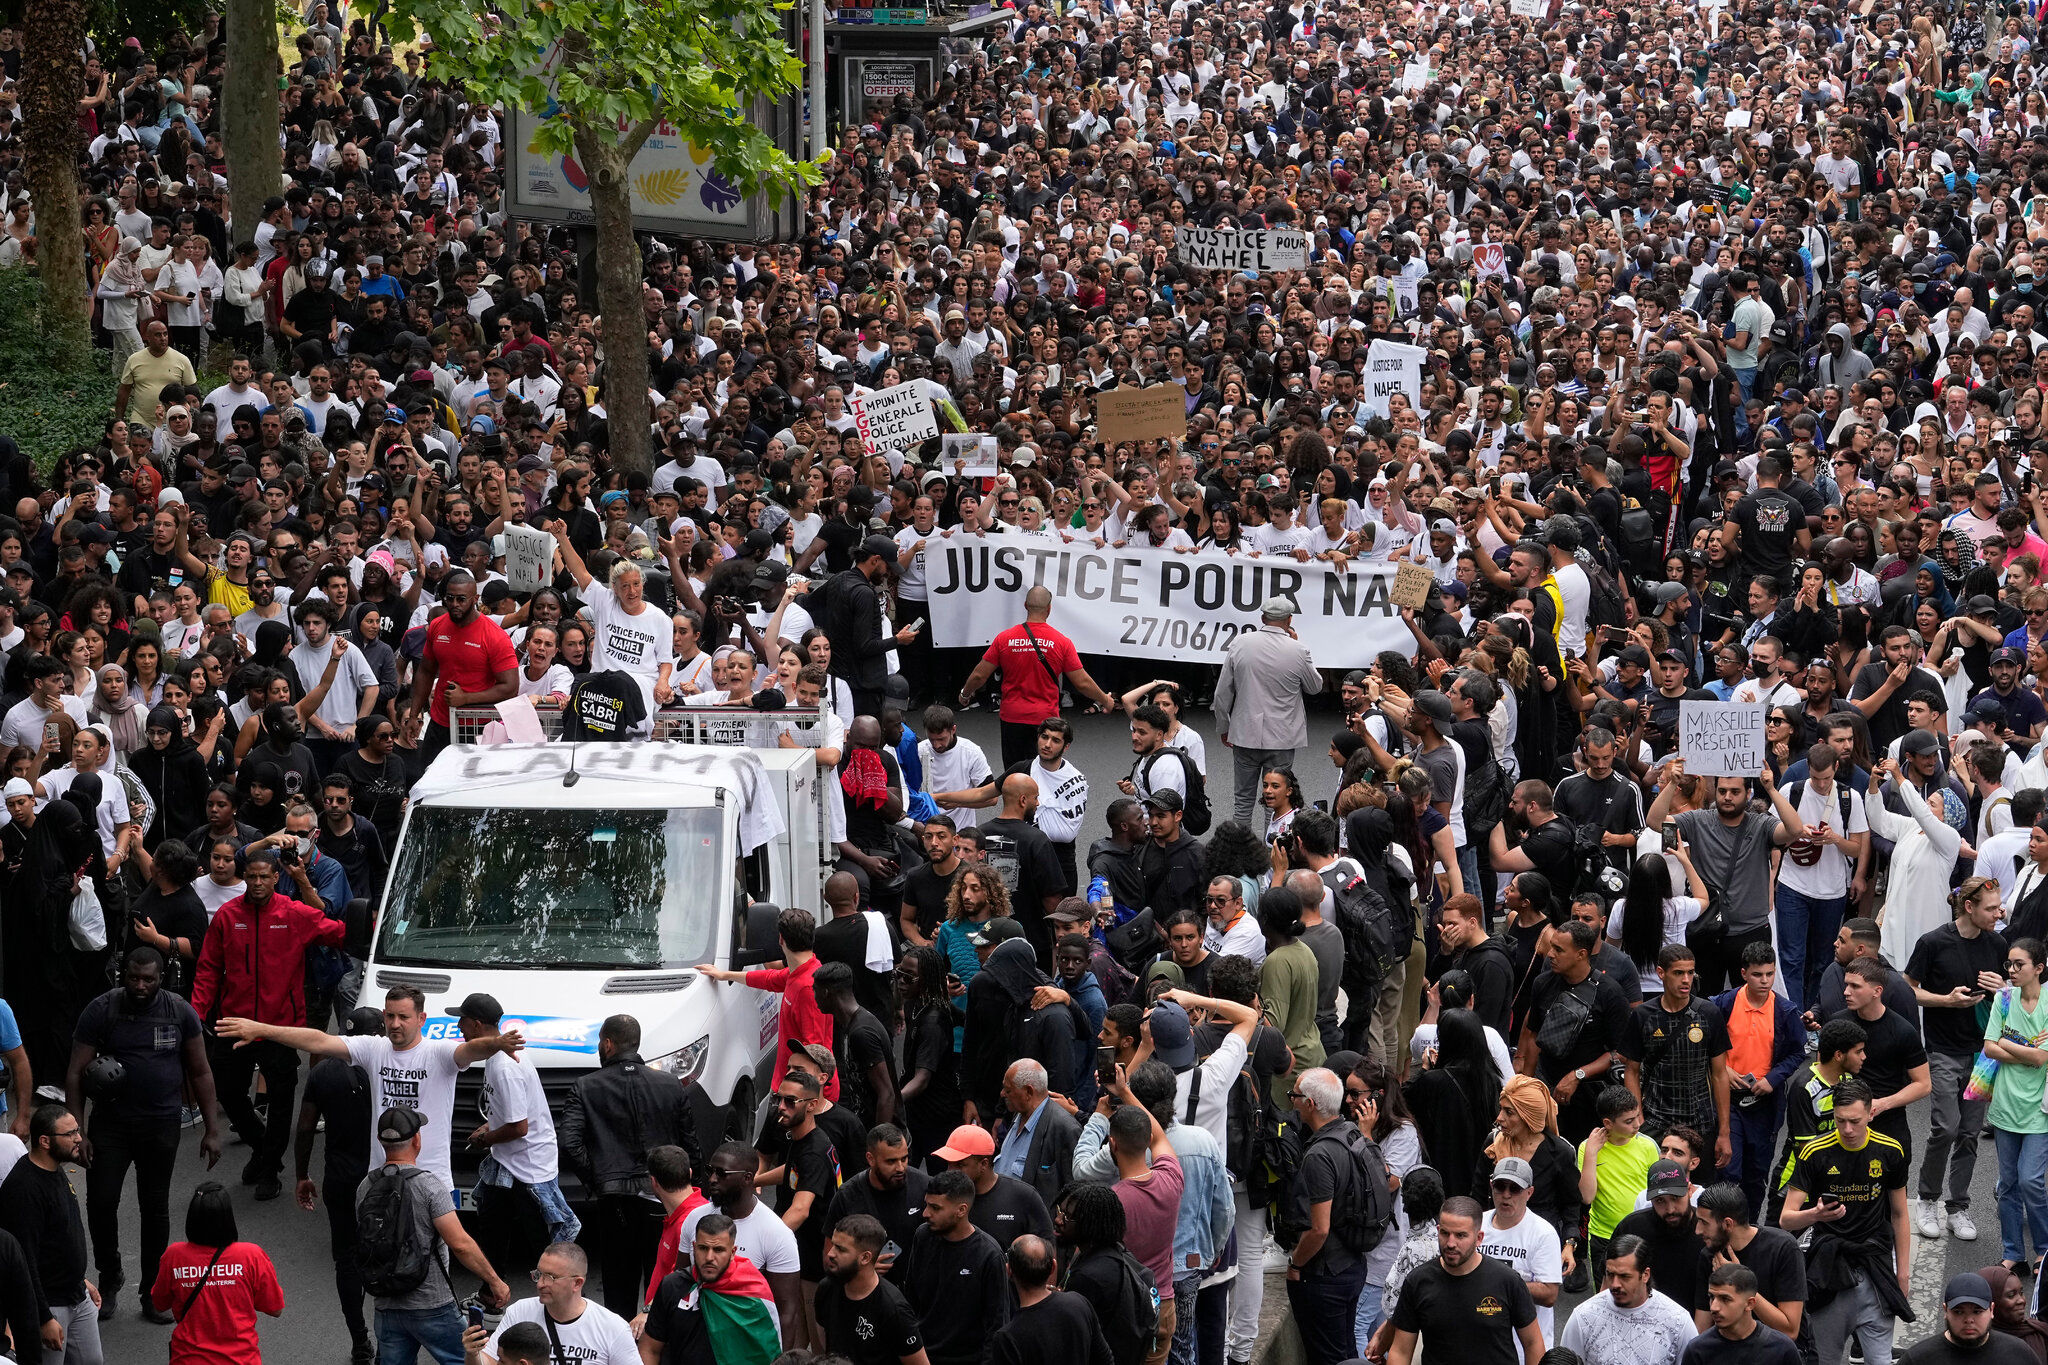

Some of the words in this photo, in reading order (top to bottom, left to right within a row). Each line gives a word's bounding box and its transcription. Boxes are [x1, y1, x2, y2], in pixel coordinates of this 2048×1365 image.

[865, 86, 912, 95] OFFERTS
[566, 210, 597, 223] JCDeca
[1182, 228, 1268, 250] JUSTICE
[1276, 236, 1306, 250] POUR
[1188, 245, 1272, 270] NAHEL
[1372, 358, 1390, 372] JUSTICE
[1390, 358, 1403, 372] POUR
[855, 401, 925, 430] GÉNÉRALE
[860, 420, 907, 442] POLICE
[1758, 524, 1785, 532] PUMA
[505, 533, 545, 560] JUSTICE
[1269, 544, 1291, 553] JUSTICE
[518, 555, 535, 566] POUR
[932, 546, 1139, 604] JUSTICE
[1159, 559, 1303, 611] POUR
[1322, 571, 1401, 618] NA
[605, 623, 633, 639] JUSTICE
[634, 631, 655, 644] POUR
[608, 635, 642, 654] NAHEL
[605, 647, 641, 665] 27/06/23
[581, 701, 618, 723] SABRI
[1686, 710, 1761, 733] MARSEILLE
[1686, 730, 1751, 752] PRÉSENTE
[1053, 774, 1087, 799] JUSTIC
[1064, 786, 1086, 802] POUR
[426, 1022, 464, 1040] RE
[404, 1069, 428, 1080] POUR
[1829, 1182, 1870, 1193] Standard
[1839, 1193, 1870, 1202] artered
[1476, 1244, 1499, 1256] STICE
[1500, 1245, 1527, 1259] POUR
[567, 1345, 598, 1360] POUR
